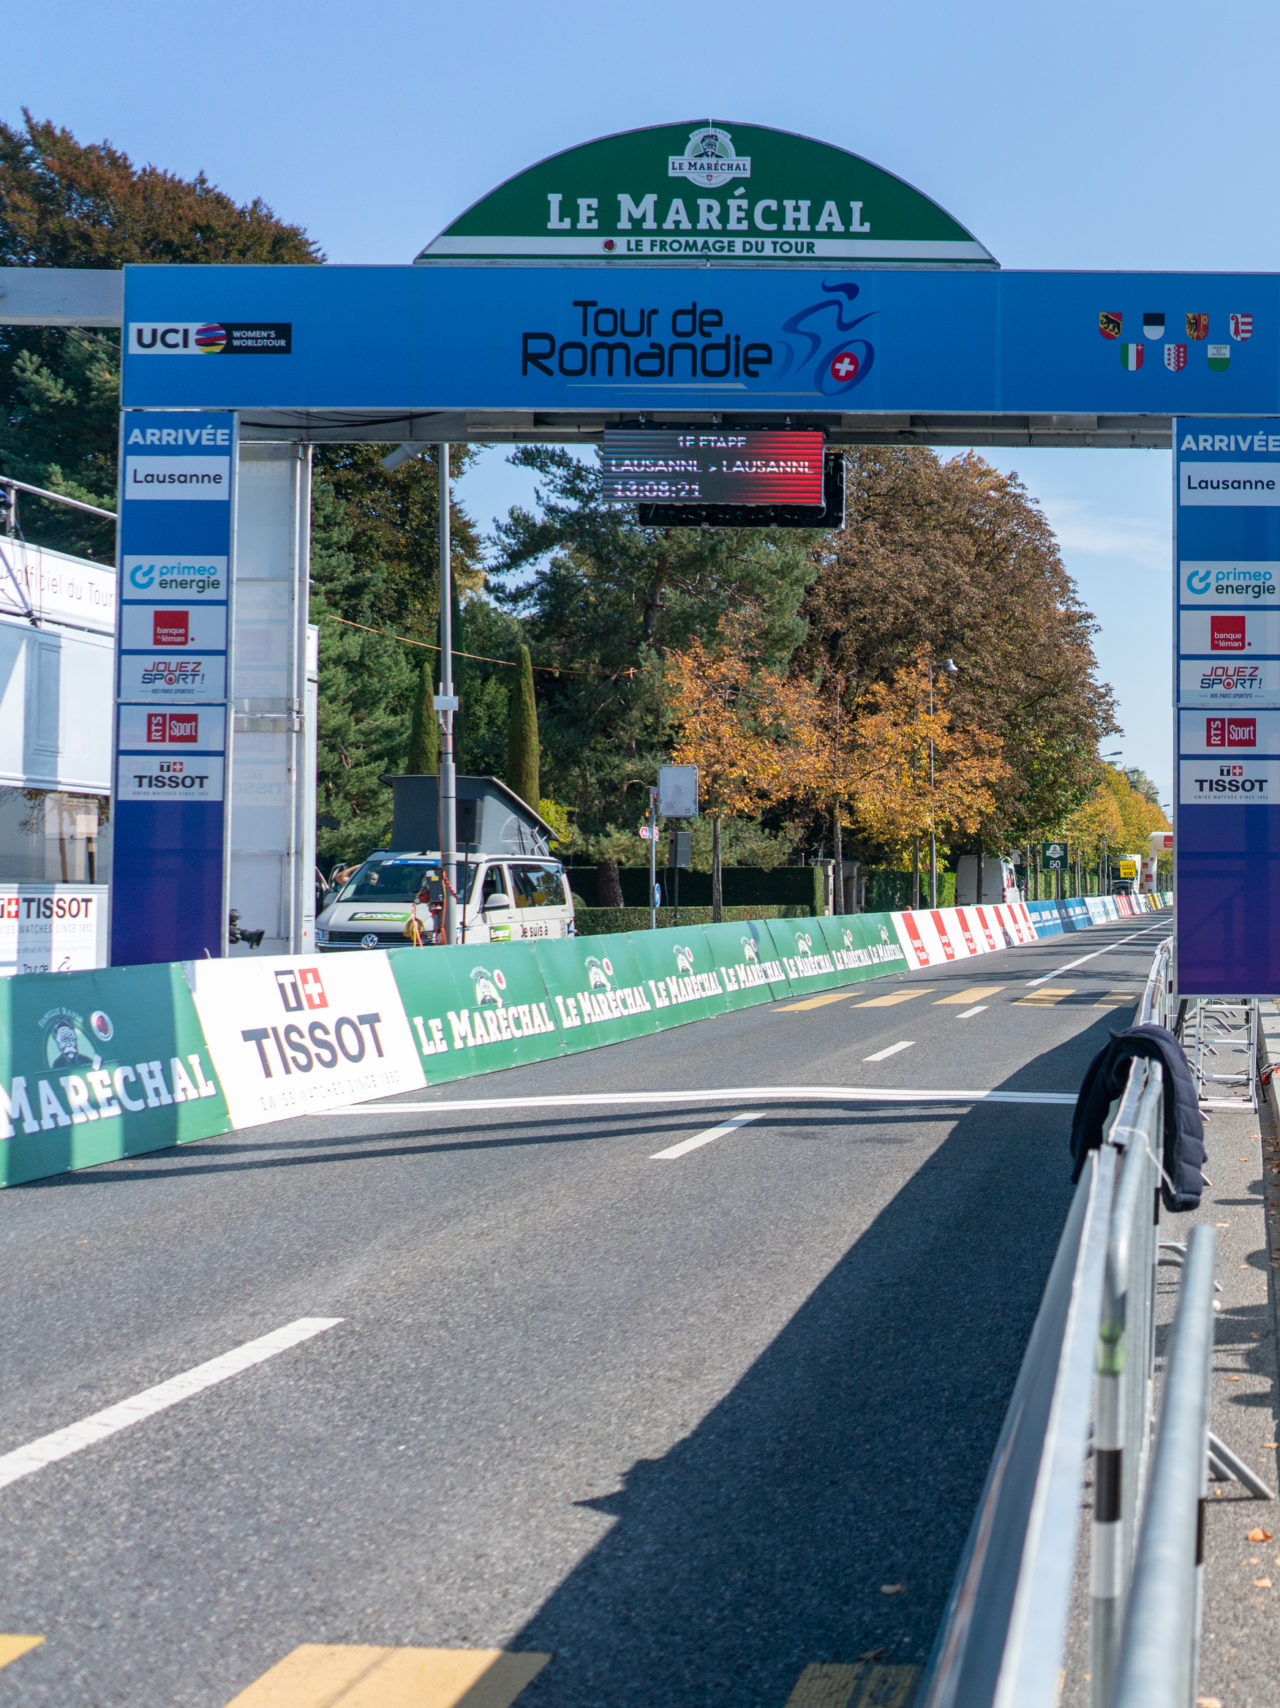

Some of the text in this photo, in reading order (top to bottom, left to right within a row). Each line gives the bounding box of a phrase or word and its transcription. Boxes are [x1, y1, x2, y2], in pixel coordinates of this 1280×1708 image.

[671, 160, 748, 172] LE MARÉCHAL
[547, 186, 871, 232] LE MARÉCHAL
[626, 239, 816, 254] LE FROMAGE DU TOUR
[572, 300, 723, 338] Tour de
[136, 328, 189, 348] UCI
[232, 330, 276, 338] WOMEN'S
[232, 339, 286, 347] WORLDTOUR
[522, 332, 773, 378] Romandie
[127, 424, 230, 446] ARRIVÉE
[133, 468, 223, 484] Lausanne
[1187, 474, 1276, 490] Lausanne
[159, 562, 218, 578] primeo
[1215, 567, 1273, 583] primeo
[159, 576, 221, 594] energie
[1214, 581, 1276, 599] energie
[156, 626, 186, 635] banque
[1214, 632, 1242, 641] banque
[143, 661, 203, 673] JOUEZ
[1202, 666, 1260, 677] JOUEZ
[151, 716, 163, 740] RTS
[170, 720, 196, 737] Sport
[1210, 720, 1222, 744] RTS
[1229, 724, 1254, 741] Sport
[133, 775, 209, 788] TISSOT
[1194, 779, 1268, 792] TISSOT
[1049, 860, 1061, 869] 50
[22, 897, 93, 919] TISSOT
[648, 979, 671, 1009] LE
[555, 995, 582, 1029] LE
[412, 998, 556, 1056] LE MARÉCHAL
[240, 1012, 385, 1079] TISSOT
[0, 1054, 217, 1140] MARÉCHAL
